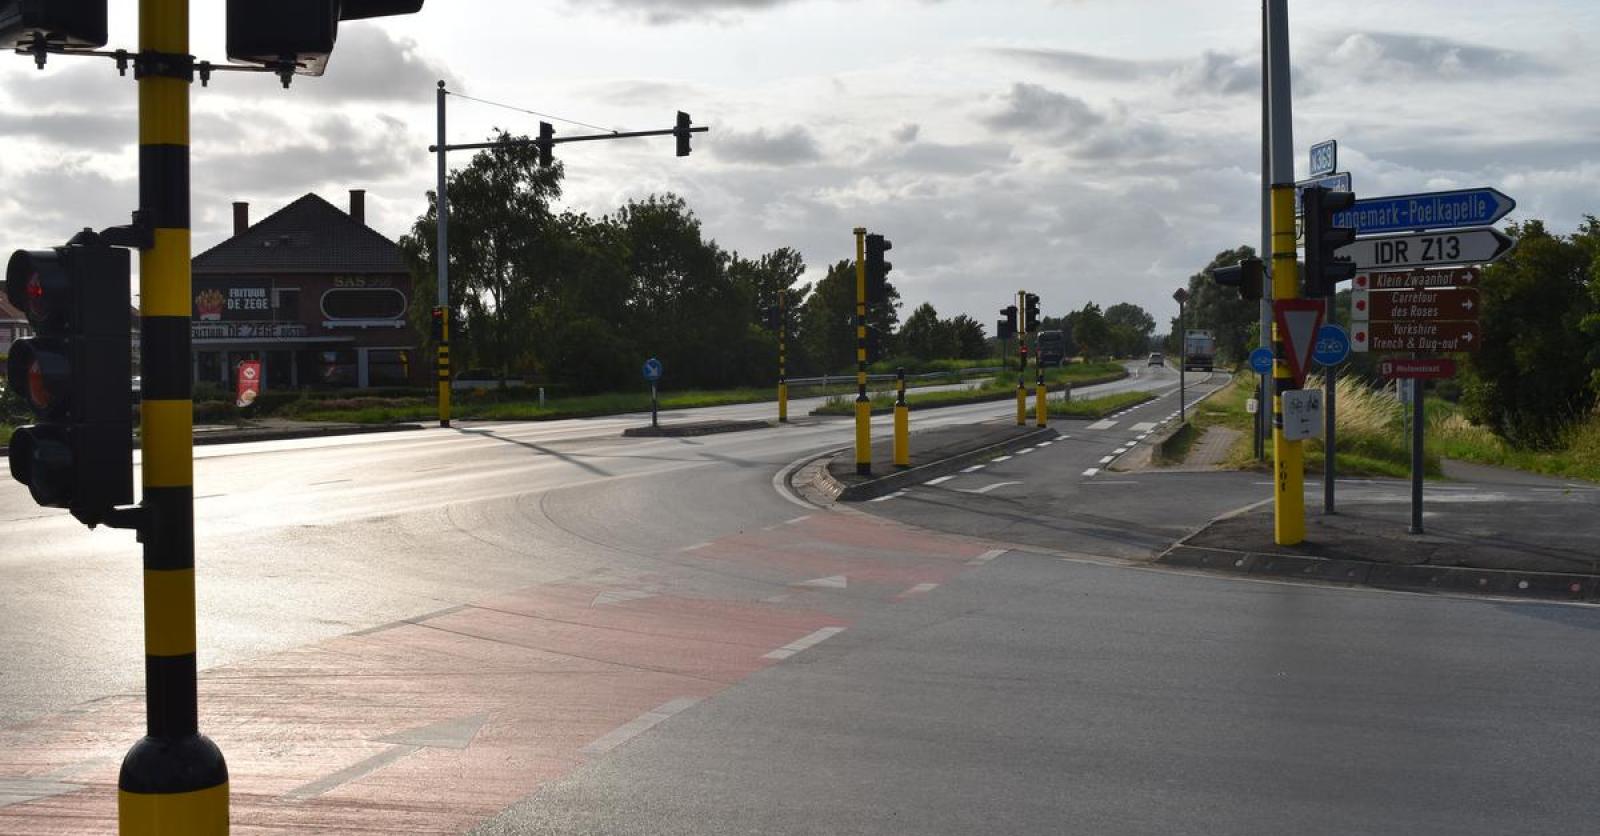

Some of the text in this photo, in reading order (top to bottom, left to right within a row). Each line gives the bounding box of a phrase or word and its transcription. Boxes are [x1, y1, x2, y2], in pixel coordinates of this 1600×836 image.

[1375, 236, 1461, 265] IDR Z13
[1376, 271, 1454, 287] Klein Zwaanhof
[1391, 291, 1438, 303] Carrefour
[227, 298, 269, 309] DE ZEGE
[1391, 305, 1438, 317] des Roses
[1393, 323, 1437, 335] Yorkshire
[1373, 337, 1459, 351] Trench & Dug-out
